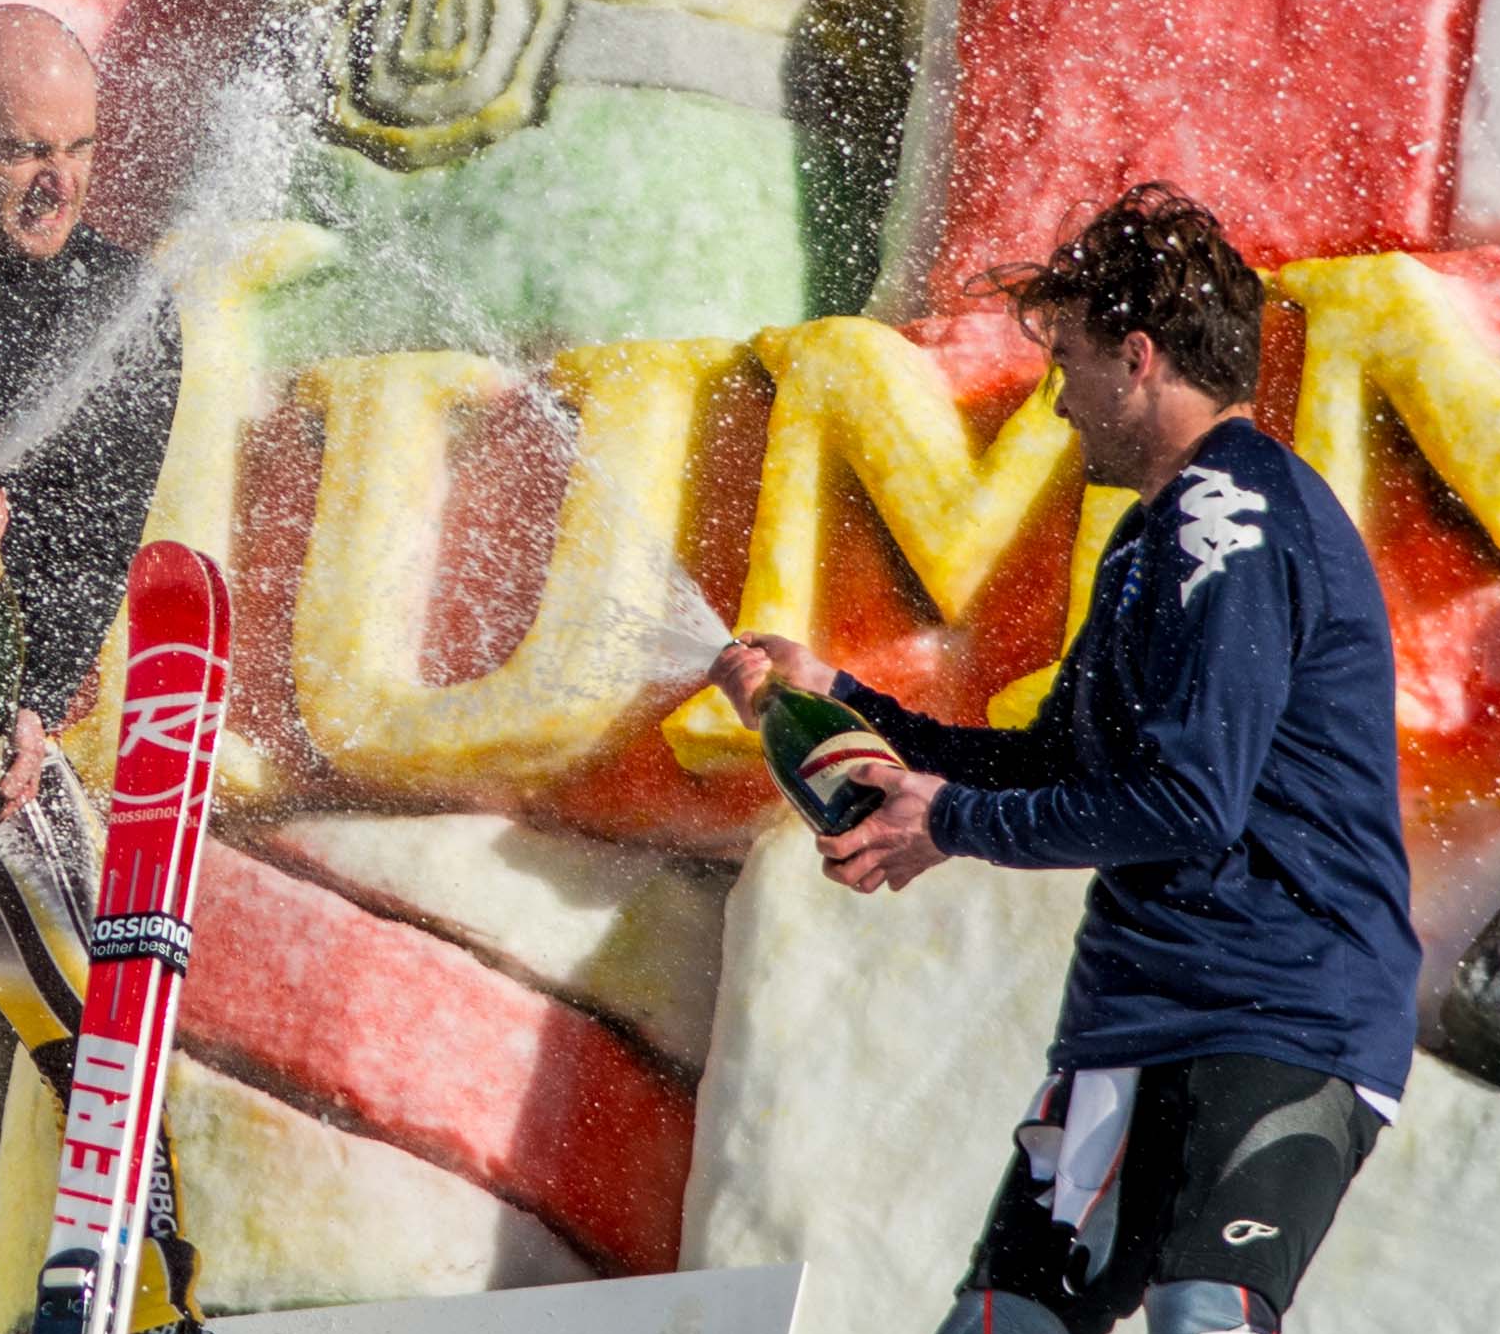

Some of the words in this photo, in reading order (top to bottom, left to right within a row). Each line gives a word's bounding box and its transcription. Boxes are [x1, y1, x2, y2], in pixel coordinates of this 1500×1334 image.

[108, 804, 182, 825] ROSSIGNOL
[91, 939, 136, 957] nother
[138, 938, 174, 958] best
[48, 1033, 140, 1255] HERO
